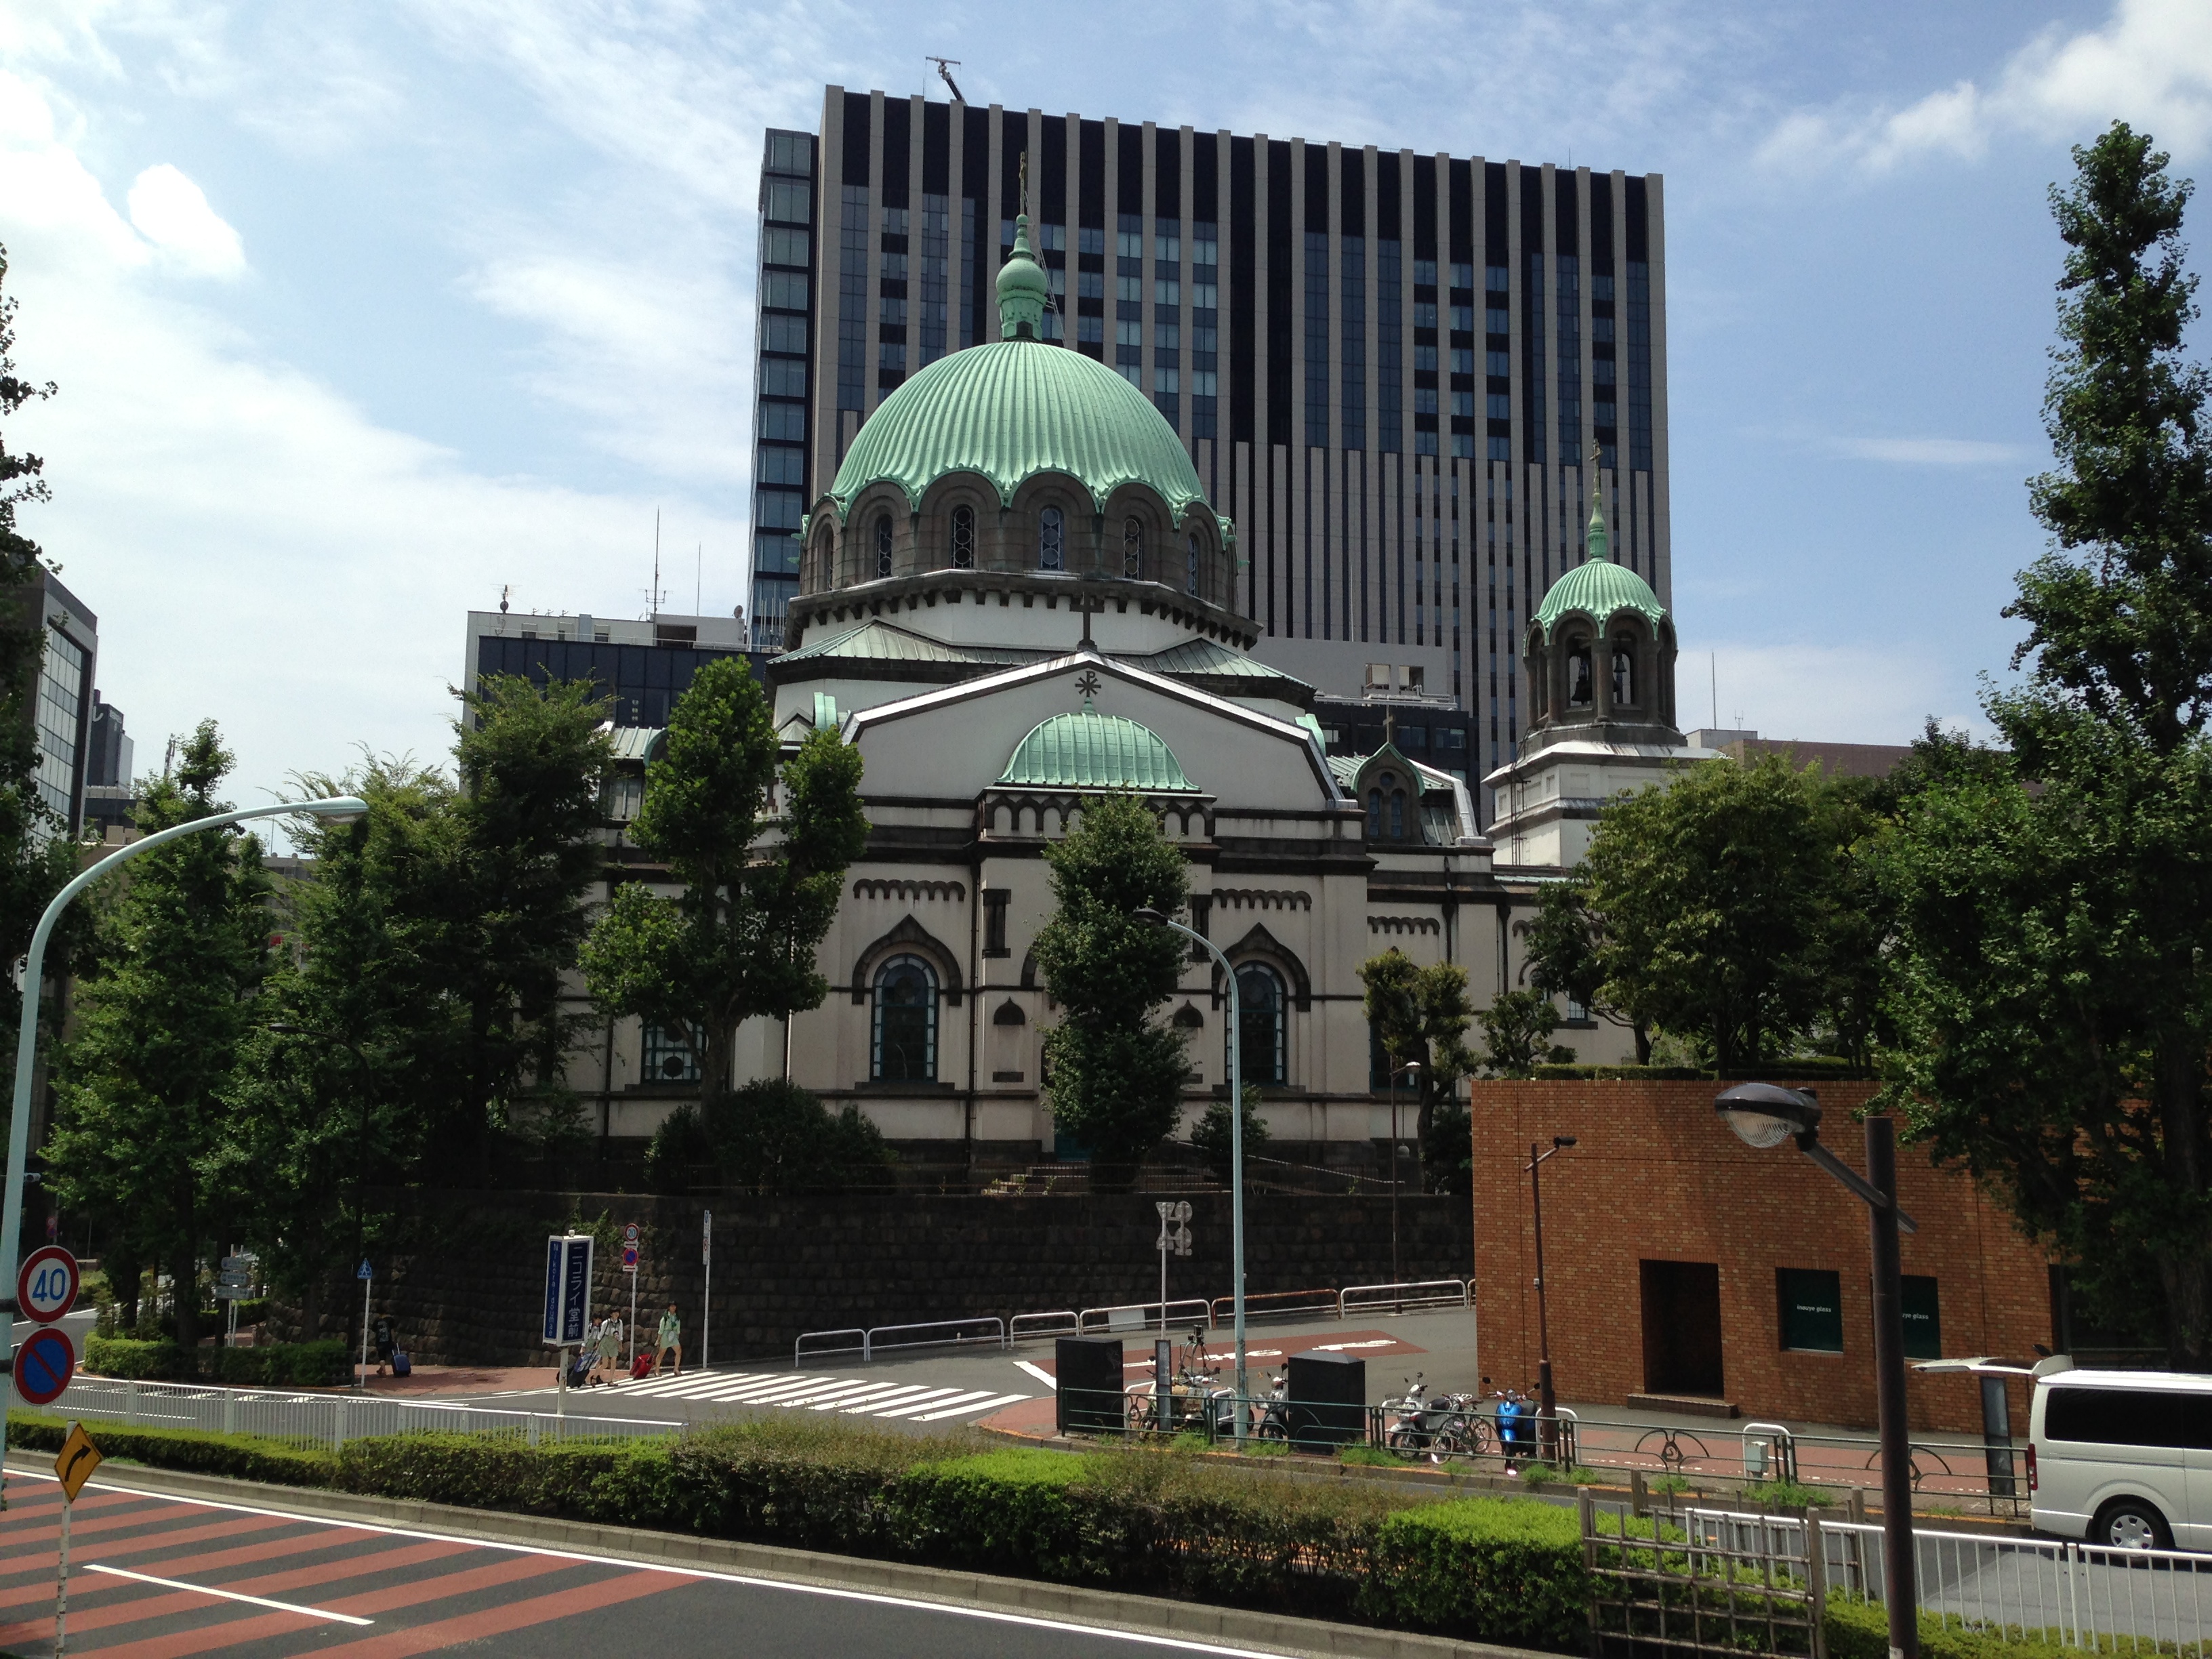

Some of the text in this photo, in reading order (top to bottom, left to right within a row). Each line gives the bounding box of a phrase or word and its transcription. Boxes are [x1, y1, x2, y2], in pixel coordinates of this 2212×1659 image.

[32, 1268, 66, 1302] 40
[568, 1246, 583, 1338] ニコライ堂前
[1816, 1305, 1832, 1313] glass
